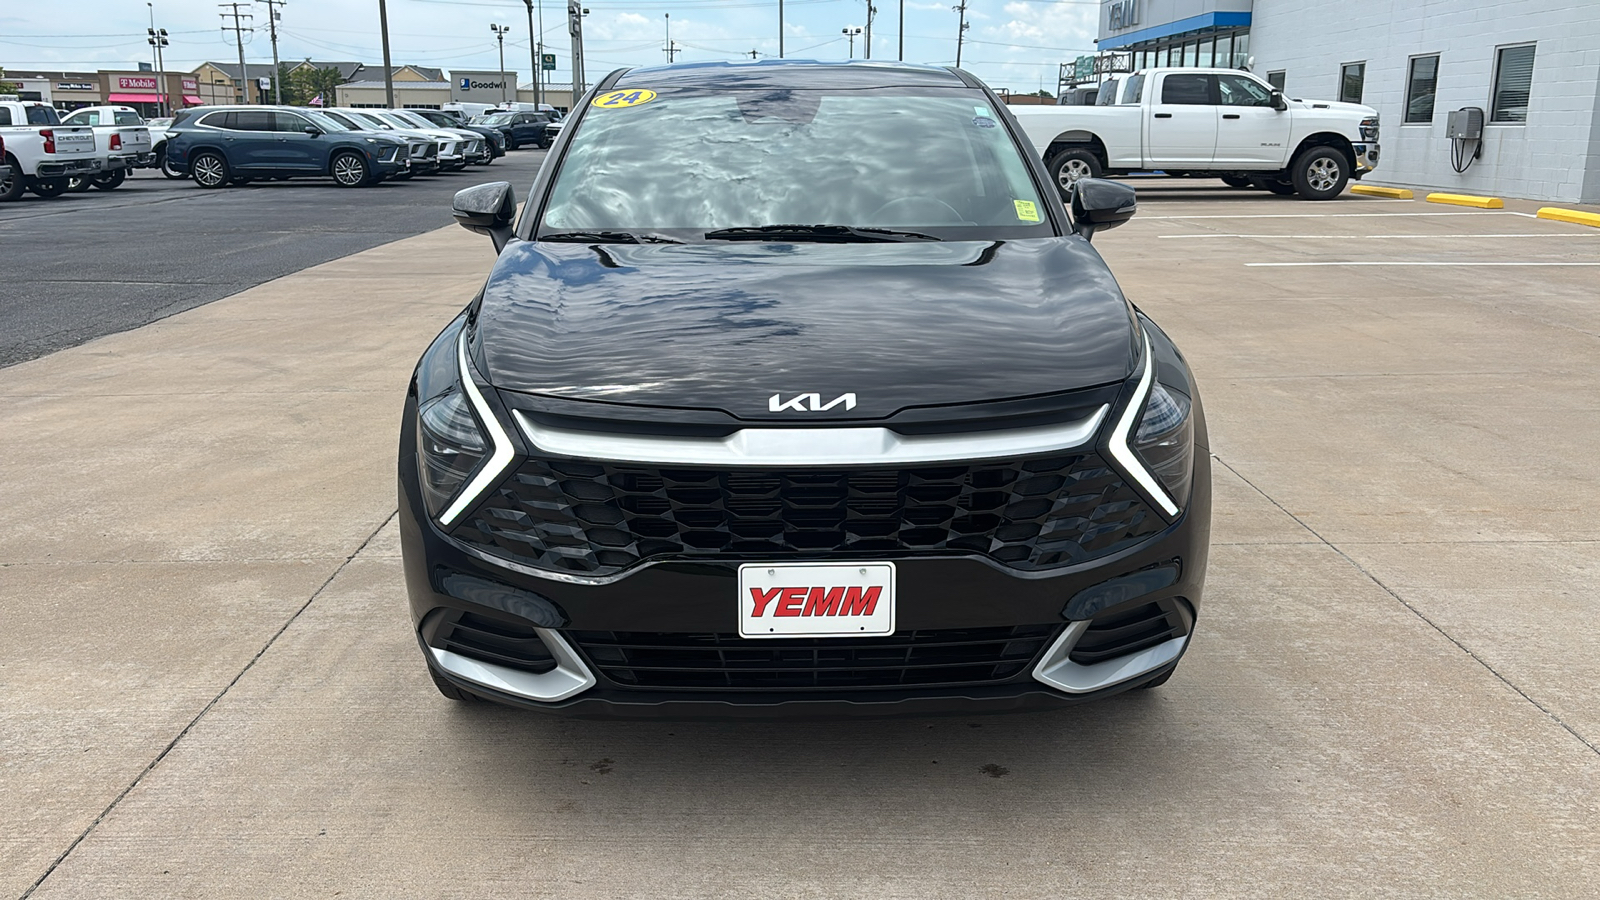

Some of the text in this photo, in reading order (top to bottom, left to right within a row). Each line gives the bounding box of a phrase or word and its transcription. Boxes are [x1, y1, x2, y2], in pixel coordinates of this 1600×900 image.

[129, 79, 155, 88] Mobile
[470, 81, 507, 89] Goodwil
[603, 91, 643, 106] 24
[749, 586, 884, 618] YEMM
